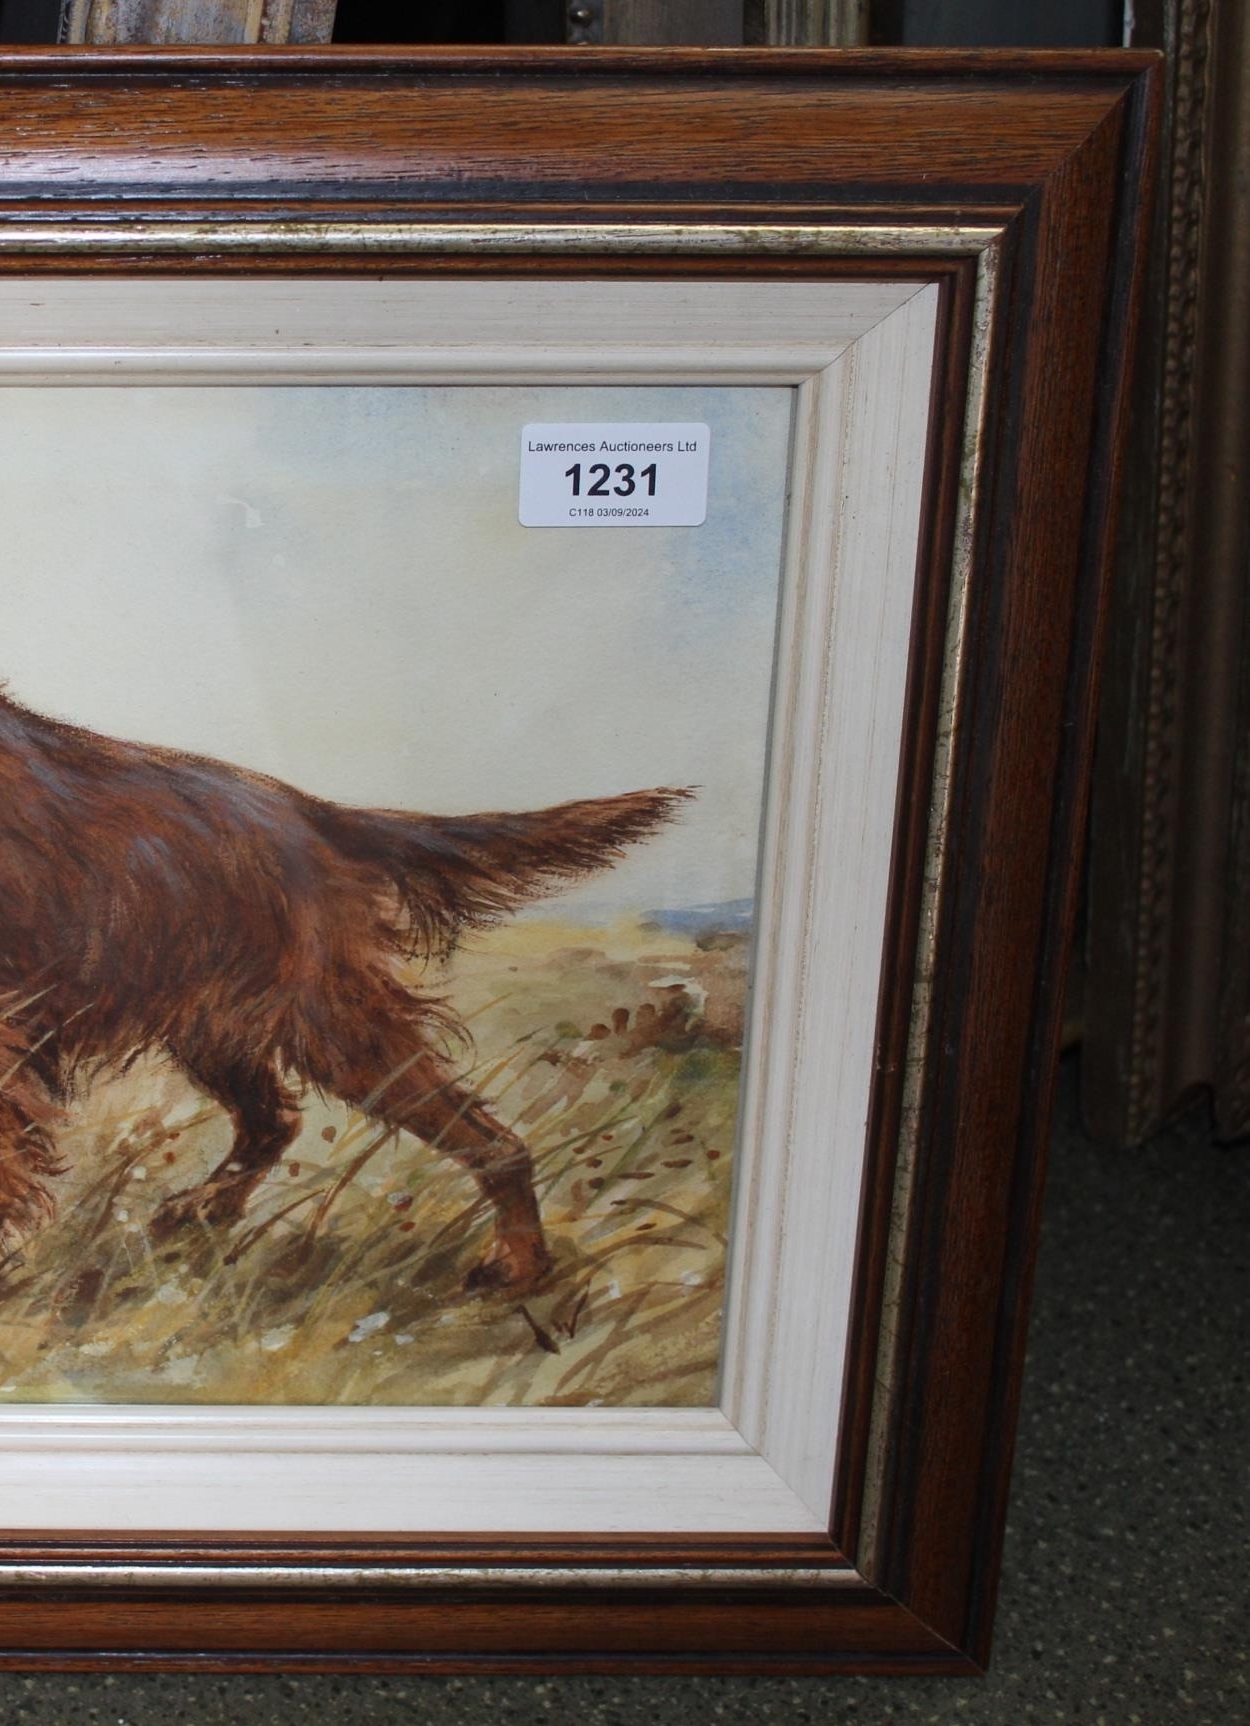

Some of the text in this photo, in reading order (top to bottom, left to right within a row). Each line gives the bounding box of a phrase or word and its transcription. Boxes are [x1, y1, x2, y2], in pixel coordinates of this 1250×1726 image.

[528, 441, 697, 452] Lawrences Auctioneers Ltd
[565, 463, 657, 496] 1231
[569, 508, 650, 517] C118 03/09/2024
